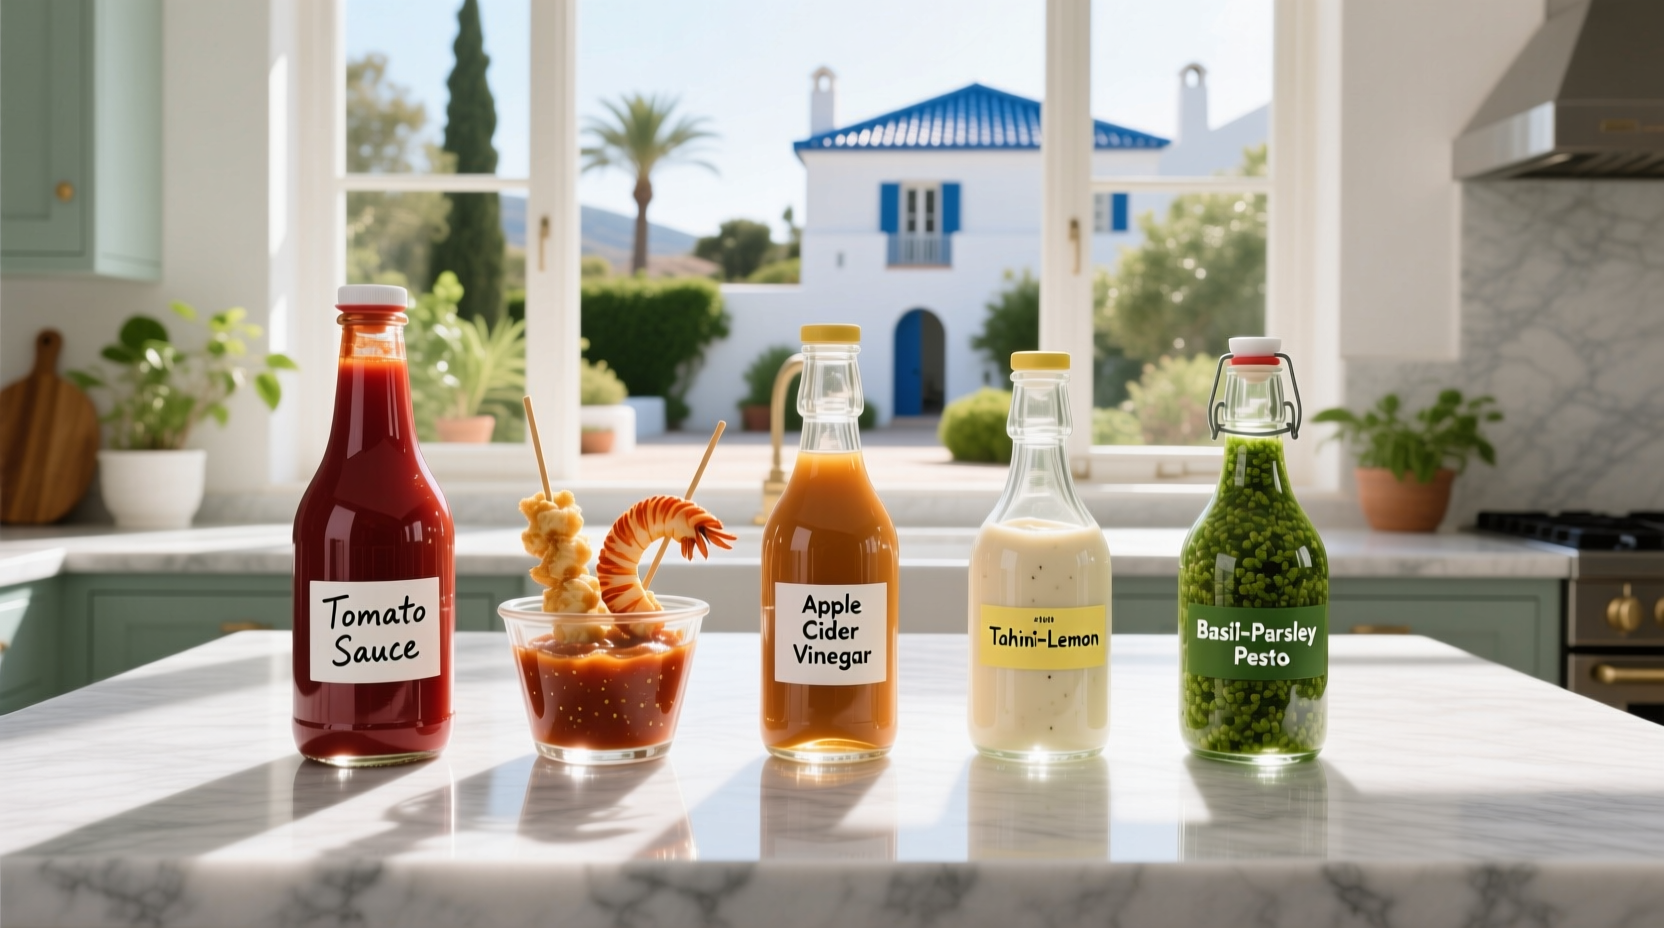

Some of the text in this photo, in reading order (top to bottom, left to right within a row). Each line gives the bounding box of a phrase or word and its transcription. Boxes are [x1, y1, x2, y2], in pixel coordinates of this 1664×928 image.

[322, 594, 426, 630] Tomato
[802, 593, 862, 619] Apple
[802, 619, 859, 640] Cider
[989, 625, 1099, 648] Tahini-Lemon
[1197, 619, 1317, 647] Basil-Parsley
[332, 634, 420, 667] Sauce
[793, 643, 872, 671] Vinegar
[1234, 646, 1291, 666] Pesto
